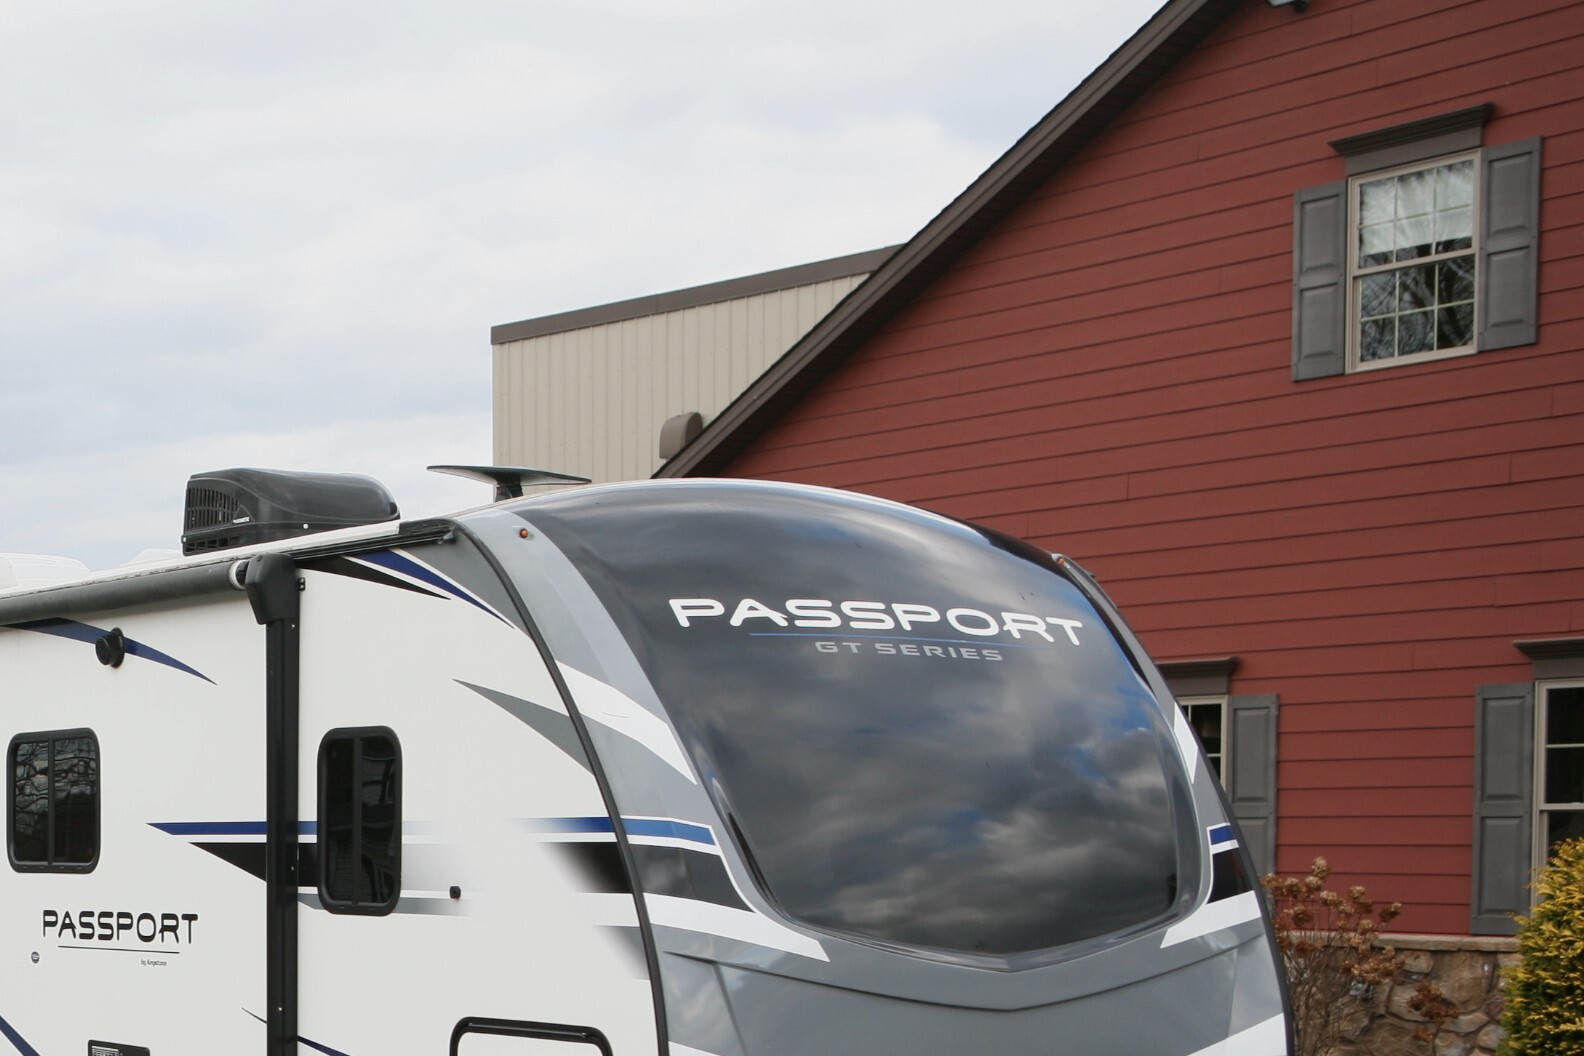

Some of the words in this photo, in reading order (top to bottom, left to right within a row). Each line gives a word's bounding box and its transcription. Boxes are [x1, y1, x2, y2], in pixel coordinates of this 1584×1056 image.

[668, 598, 1084, 646] PASSPORT
[816, 641, 862, 655] GT
[876, 643, 1004, 662] SERIES
[42, 909, 199, 945] PASSPORT
